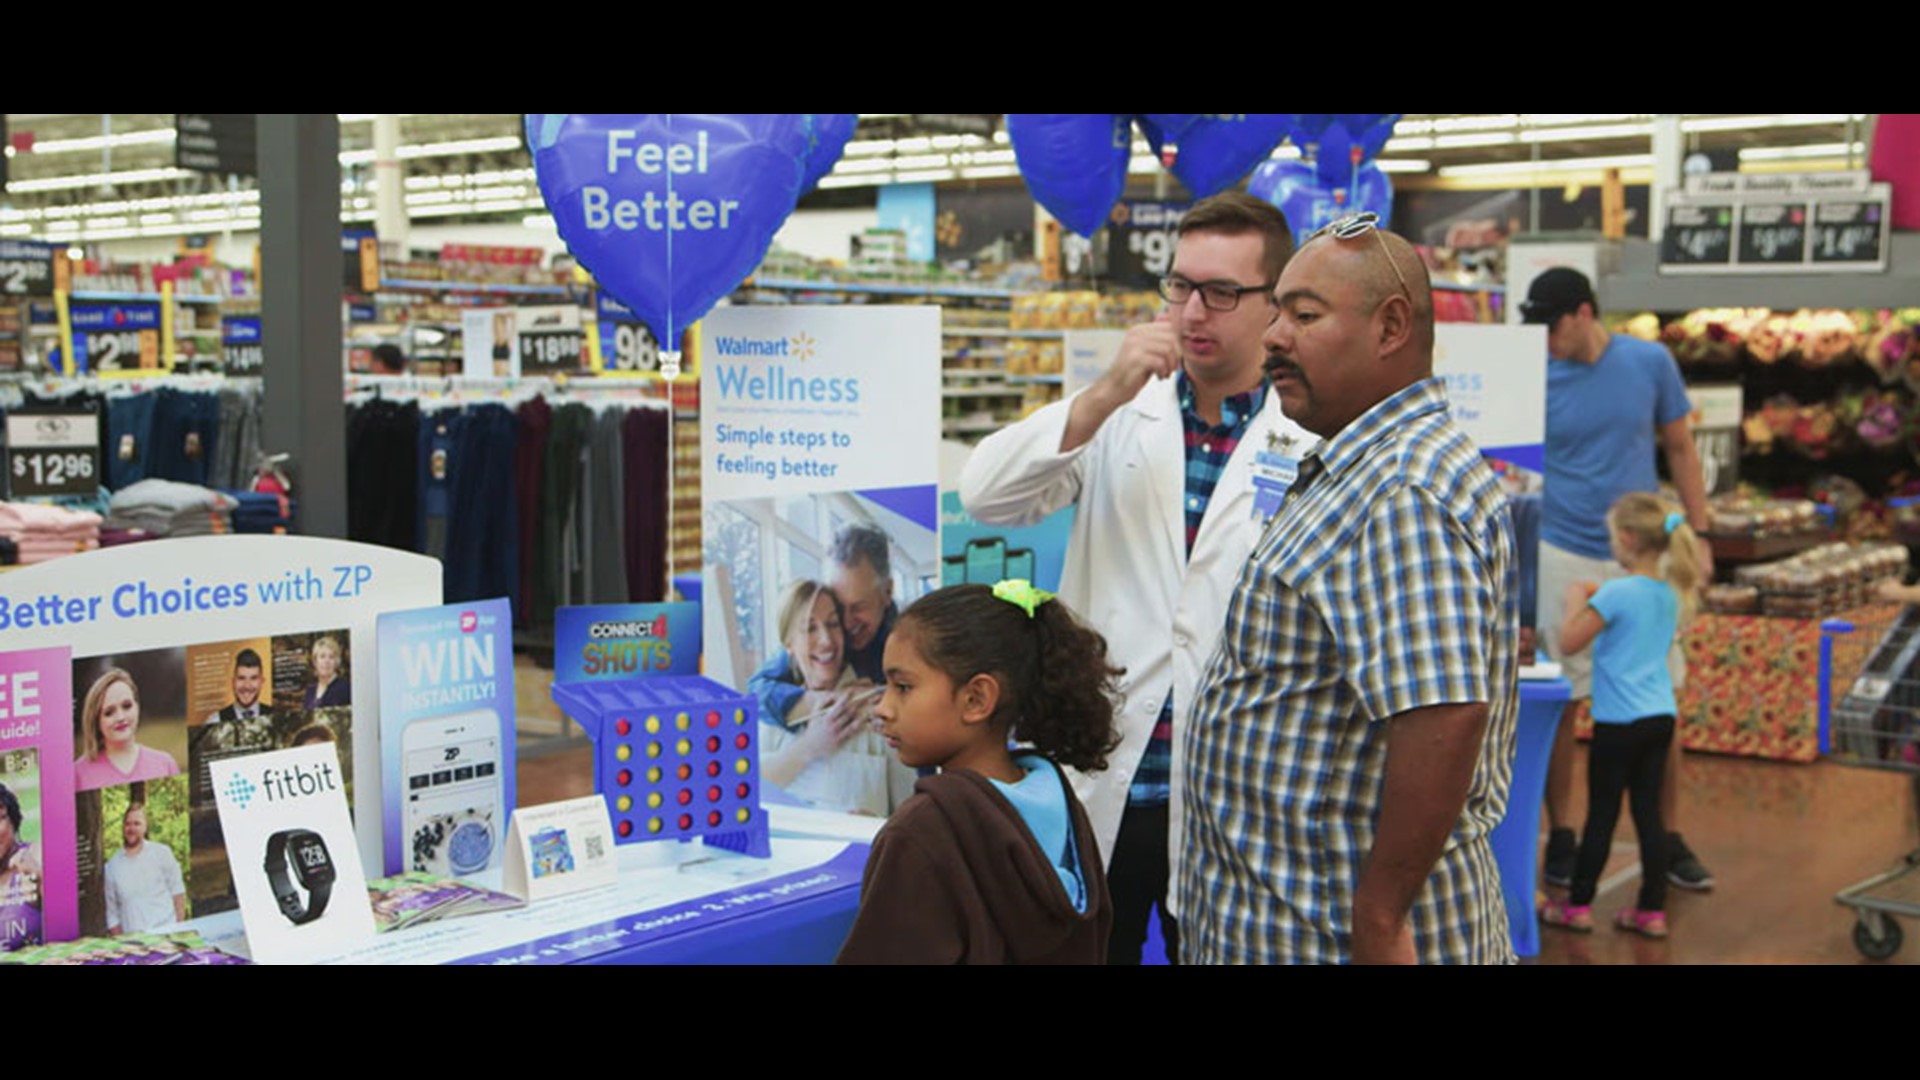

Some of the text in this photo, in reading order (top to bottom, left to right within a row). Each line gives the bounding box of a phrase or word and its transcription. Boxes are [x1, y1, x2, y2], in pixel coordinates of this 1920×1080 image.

[608, 129, 708, 173] Feel
[582, 186, 739, 230] Better
[716, 337, 788, 356] Walmart
[716, 365, 859, 402] Wellness
[716, 424, 851, 451] Simple steps to
[716, 453, 837, 480] feeling better
[112, 579, 248, 618] Choices
[258, 567, 323, 604] with
[333, 565, 372, 598] ZP
[589, 613, 668, 640] CONNECT 4
[401, 633, 496, 686] WIN
[583, 640, 671, 675] SHOTS
[263, 763, 336, 801] fitbit
